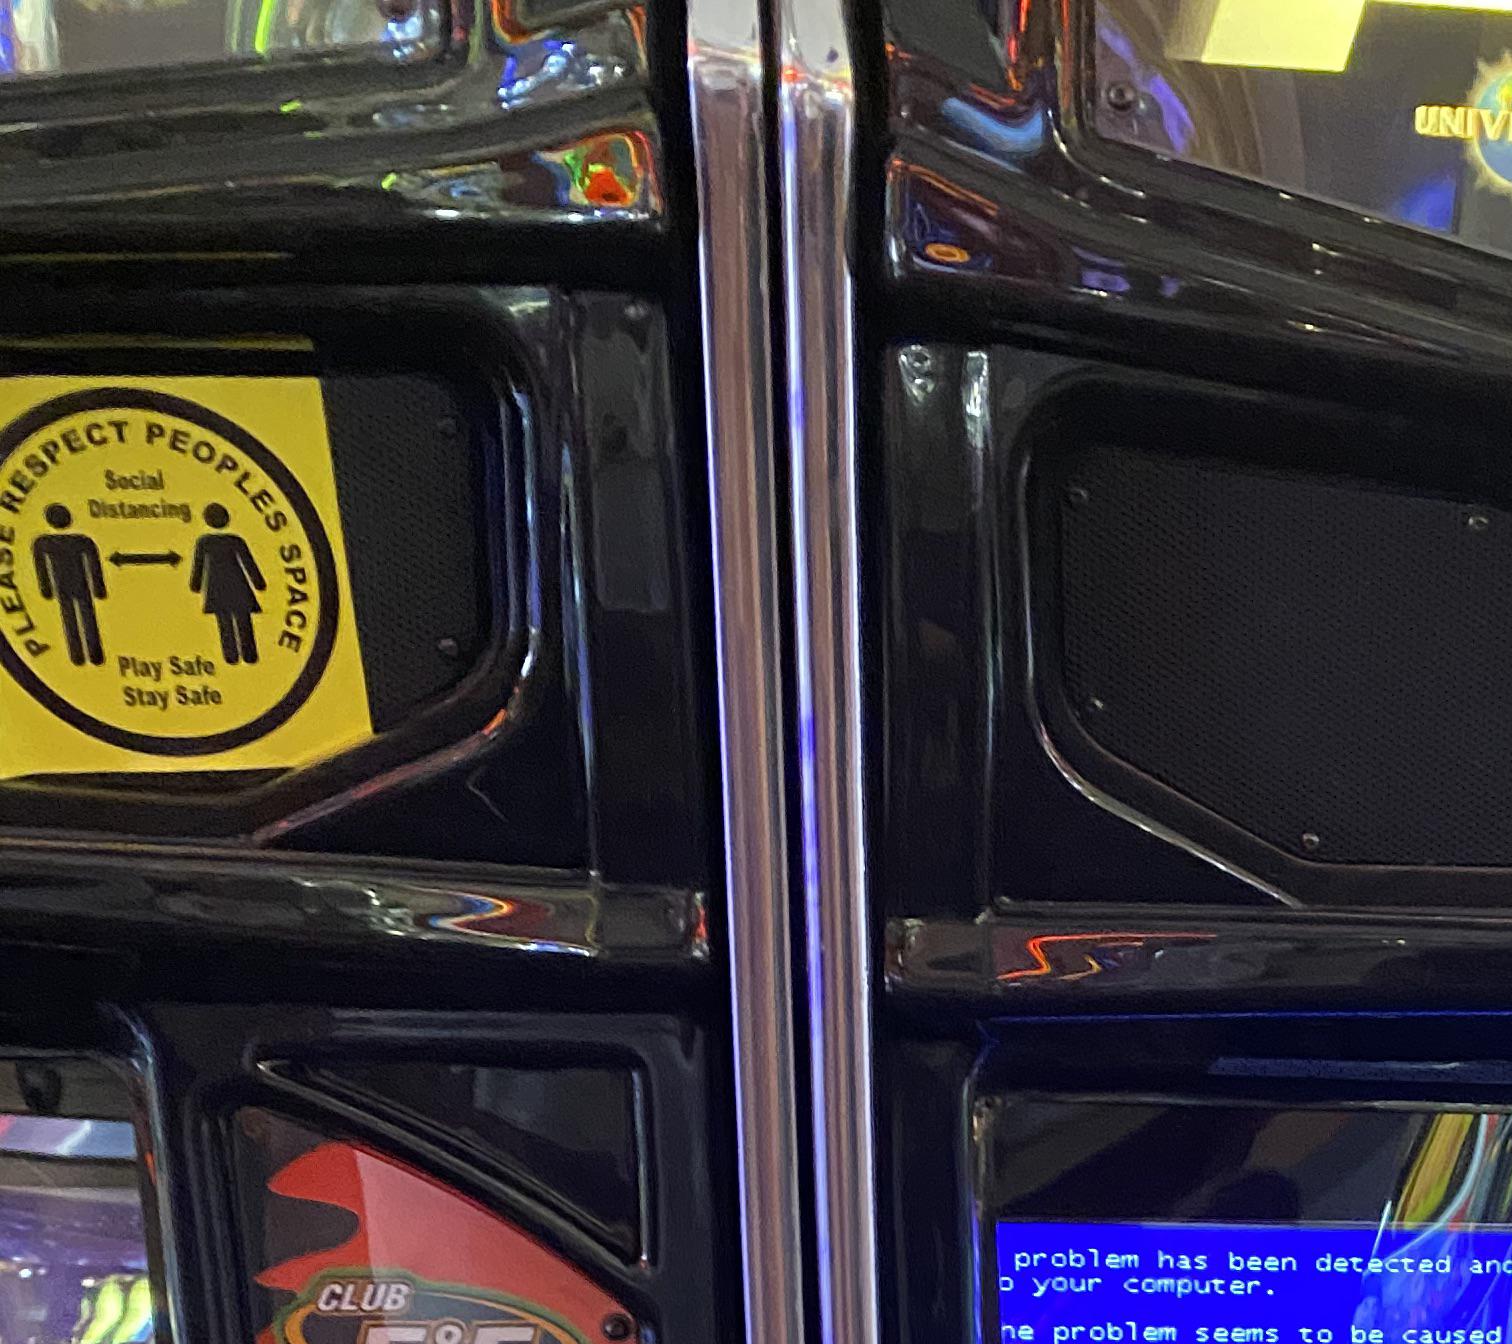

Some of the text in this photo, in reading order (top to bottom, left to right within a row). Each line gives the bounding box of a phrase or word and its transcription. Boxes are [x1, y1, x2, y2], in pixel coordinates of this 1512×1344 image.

[104, 469, 163, 491] Social
[88, 499, 192, 524] Distancing
[2, 420, 129, 515] RESPECT
[145, 421, 289, 533] PEOPLES
[278, 543, 310, 654] SPACE
[118, 655, 216, 679] Play Safe
[123, 685, 223, 710] Stay Safe
[1014, 1249, 1139, 1272] problem
[1159, 1251, 1208, 1271] has
[1229, 1252, 1297, 1272] been
[1315, 1254, 1451, 1273] detected
[317, 1283, 410, 1312] CLUB
[1033, 1276, 1275, 1297] your computer.
[1053, 1322, 1177, 1344] problem
[1195, 1325, 1279, 1343] seems
[1299, 1326, 1333, 1344] to
[1351, 1325, 1383, 1344] be
[1402, 1325, 1501, 1344] caused
